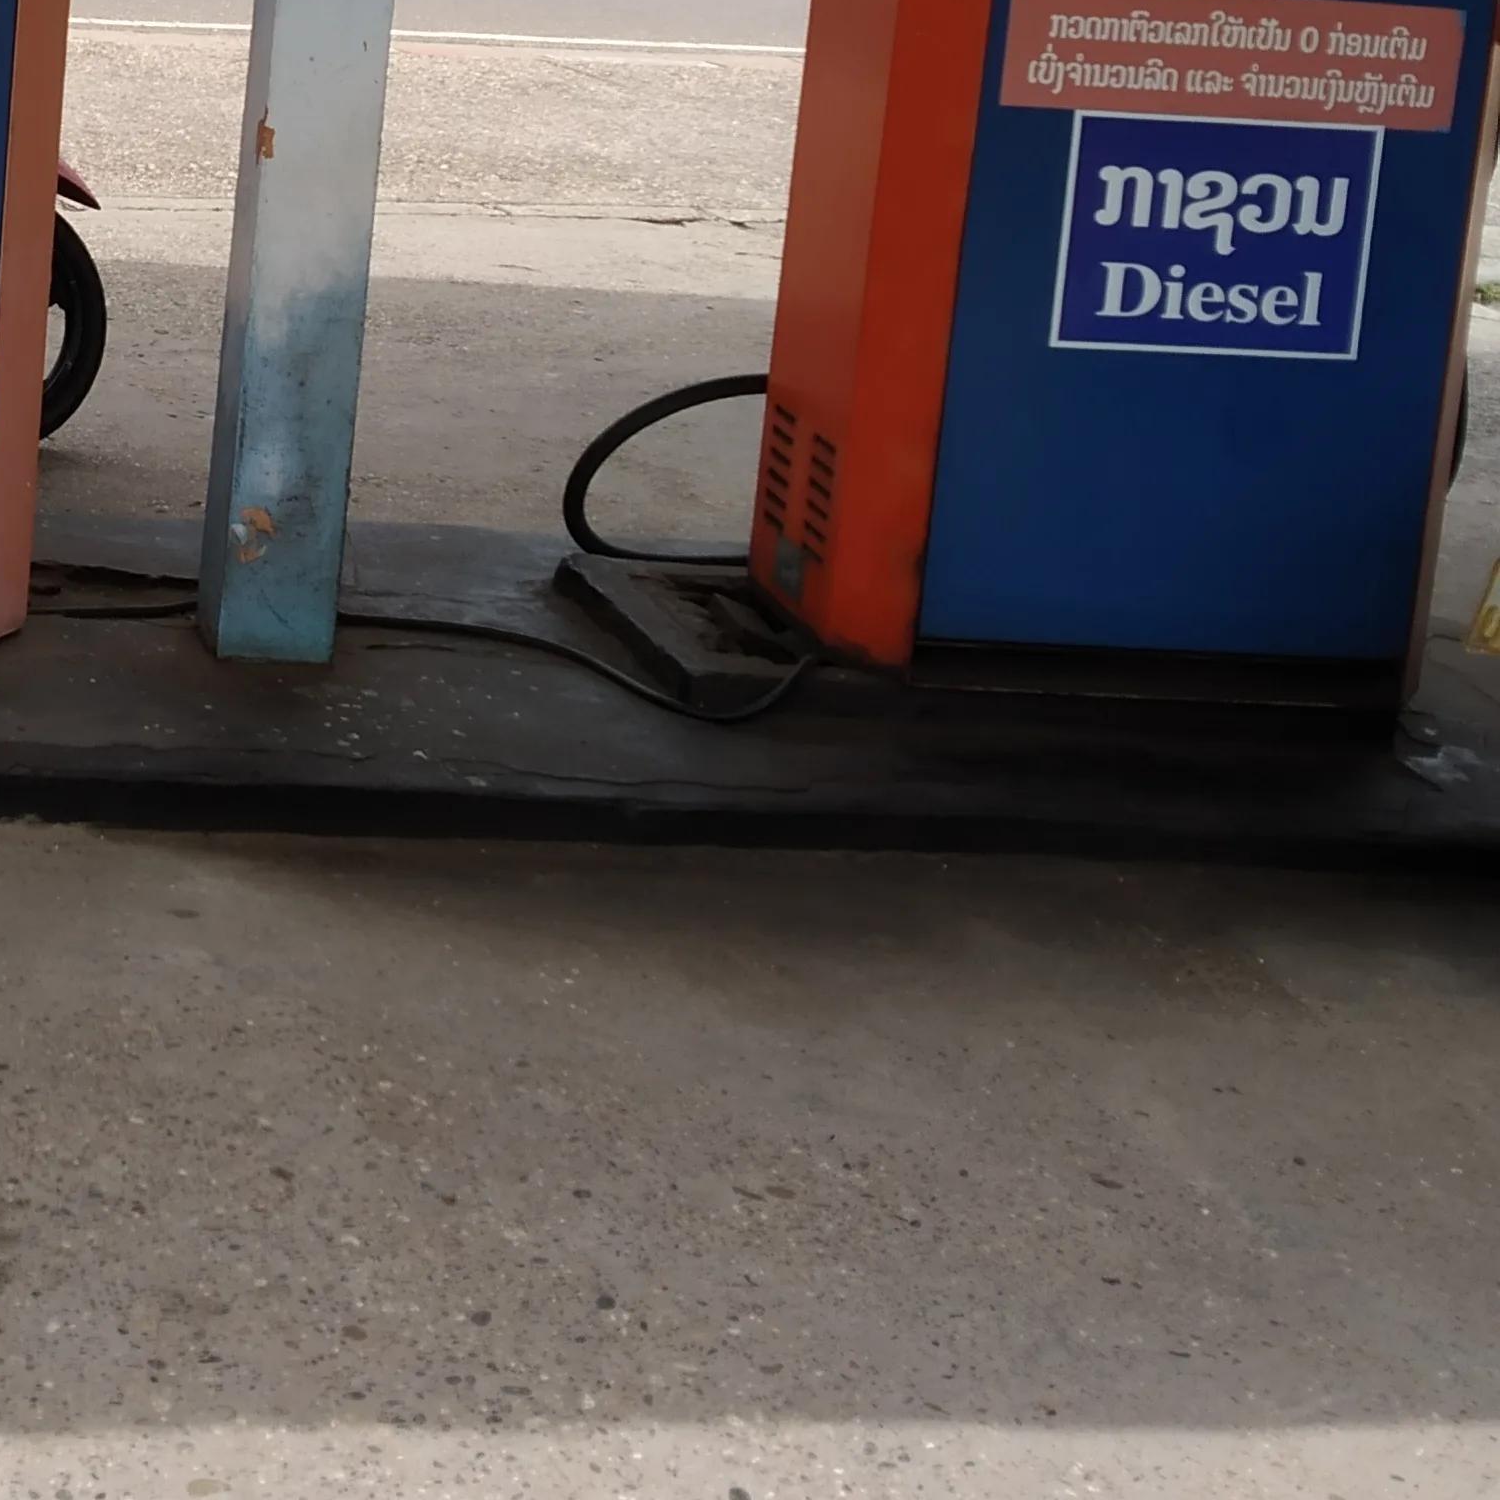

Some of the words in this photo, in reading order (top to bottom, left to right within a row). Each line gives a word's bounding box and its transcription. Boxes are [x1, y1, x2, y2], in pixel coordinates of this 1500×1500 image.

[1299, 26, 1320, 54] 0
[1185, 68, 1235, 95] ແລະ
[1094, 165, 1350, 255] ກາຊວນ
[1095, 261, 1323, 326] Diesel
